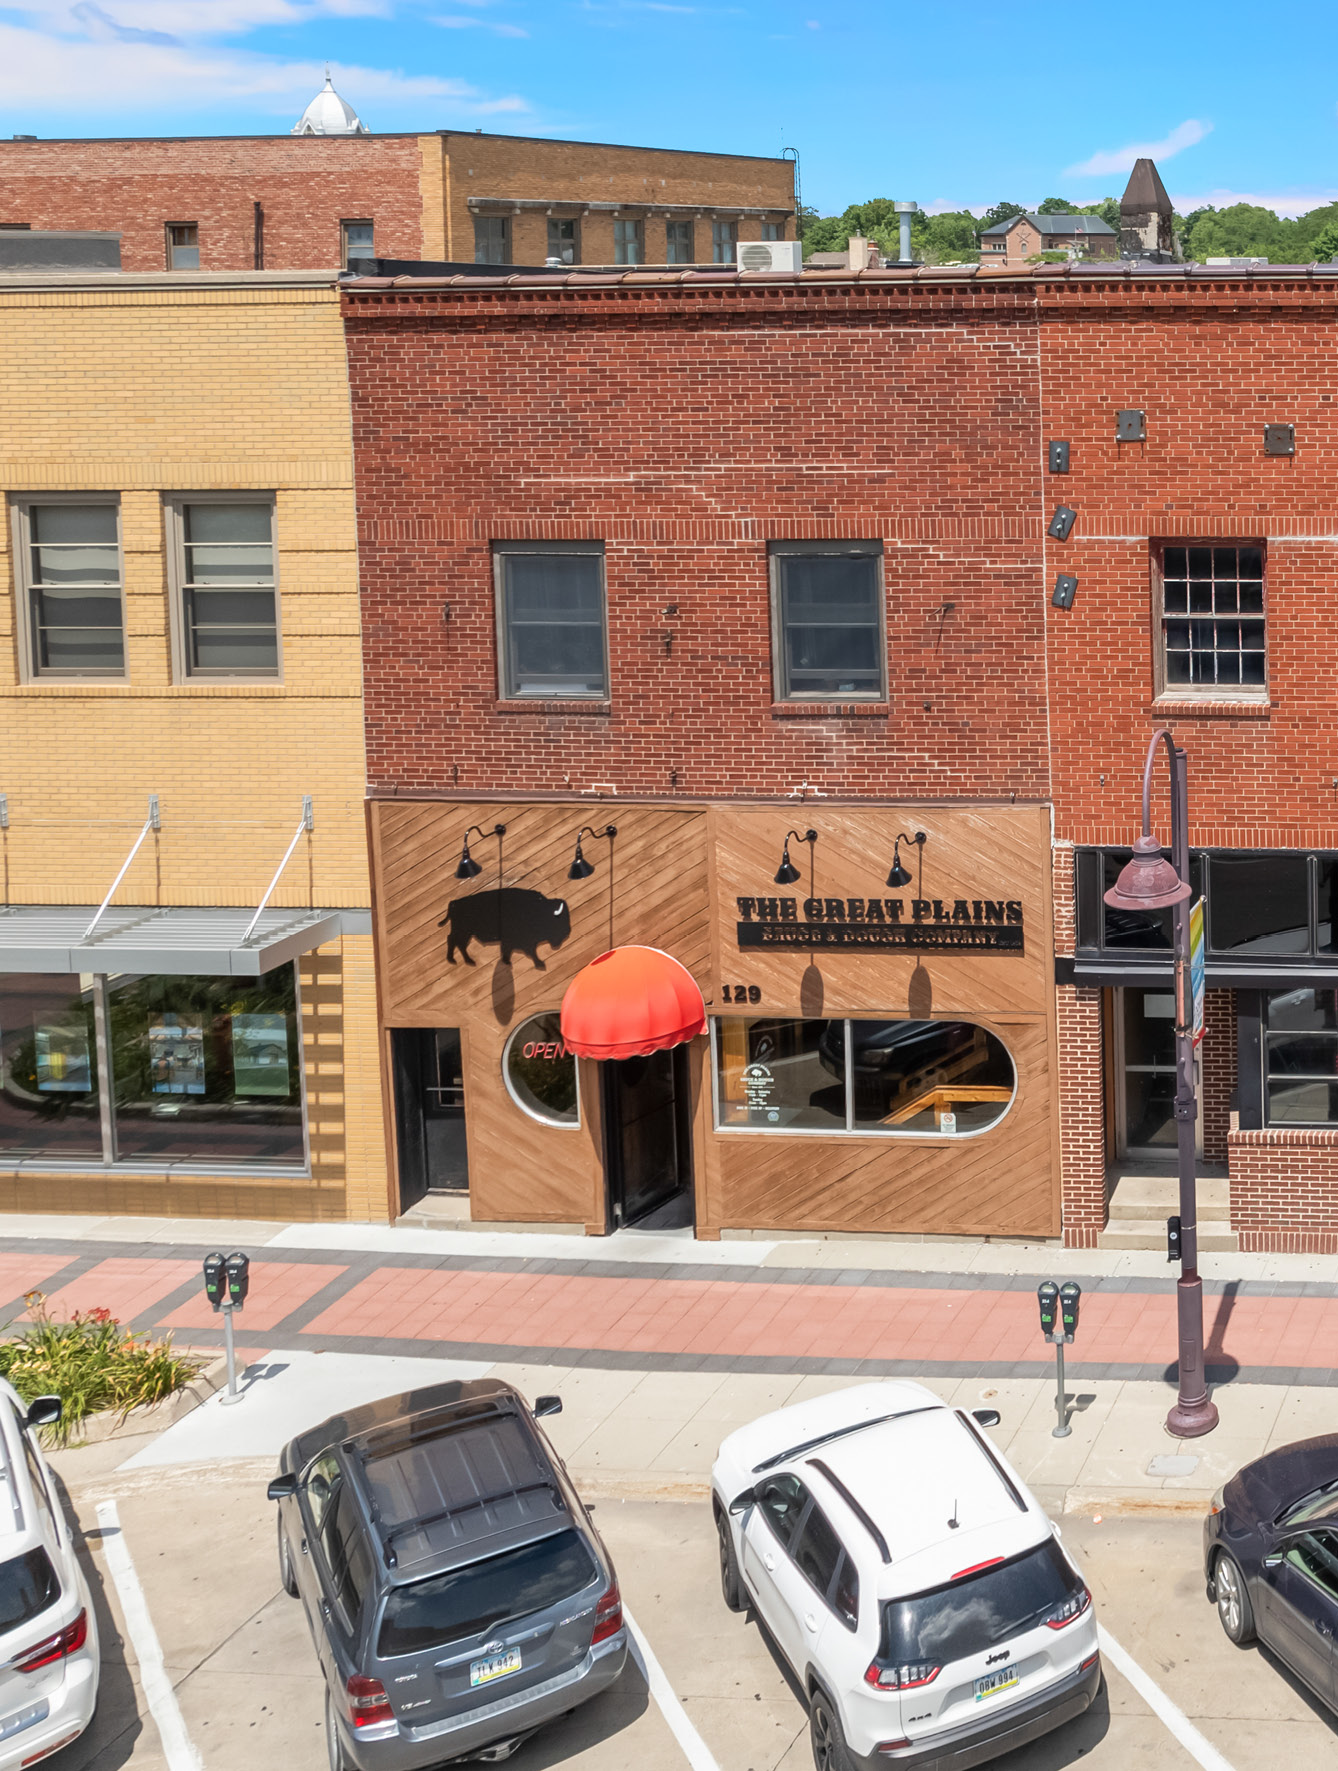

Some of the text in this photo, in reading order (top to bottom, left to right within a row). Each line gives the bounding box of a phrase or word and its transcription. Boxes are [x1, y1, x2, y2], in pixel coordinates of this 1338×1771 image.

[737, 897, 1023, 925] THE GREAT PLAINS
[762, 926, 822, 942] SAUCE
[843, 927, 906, 943] DOUGH
[910, 929, 998, 945] COMPANY
[722, 984, 761, 1004] 129
[523, 1041, 566, 1059] OPEN
[497, 1655, 514, 1671] 942
[985, 1650, 1010, 1665] Jeep
[998, 1670, 1014, 1685] 994
